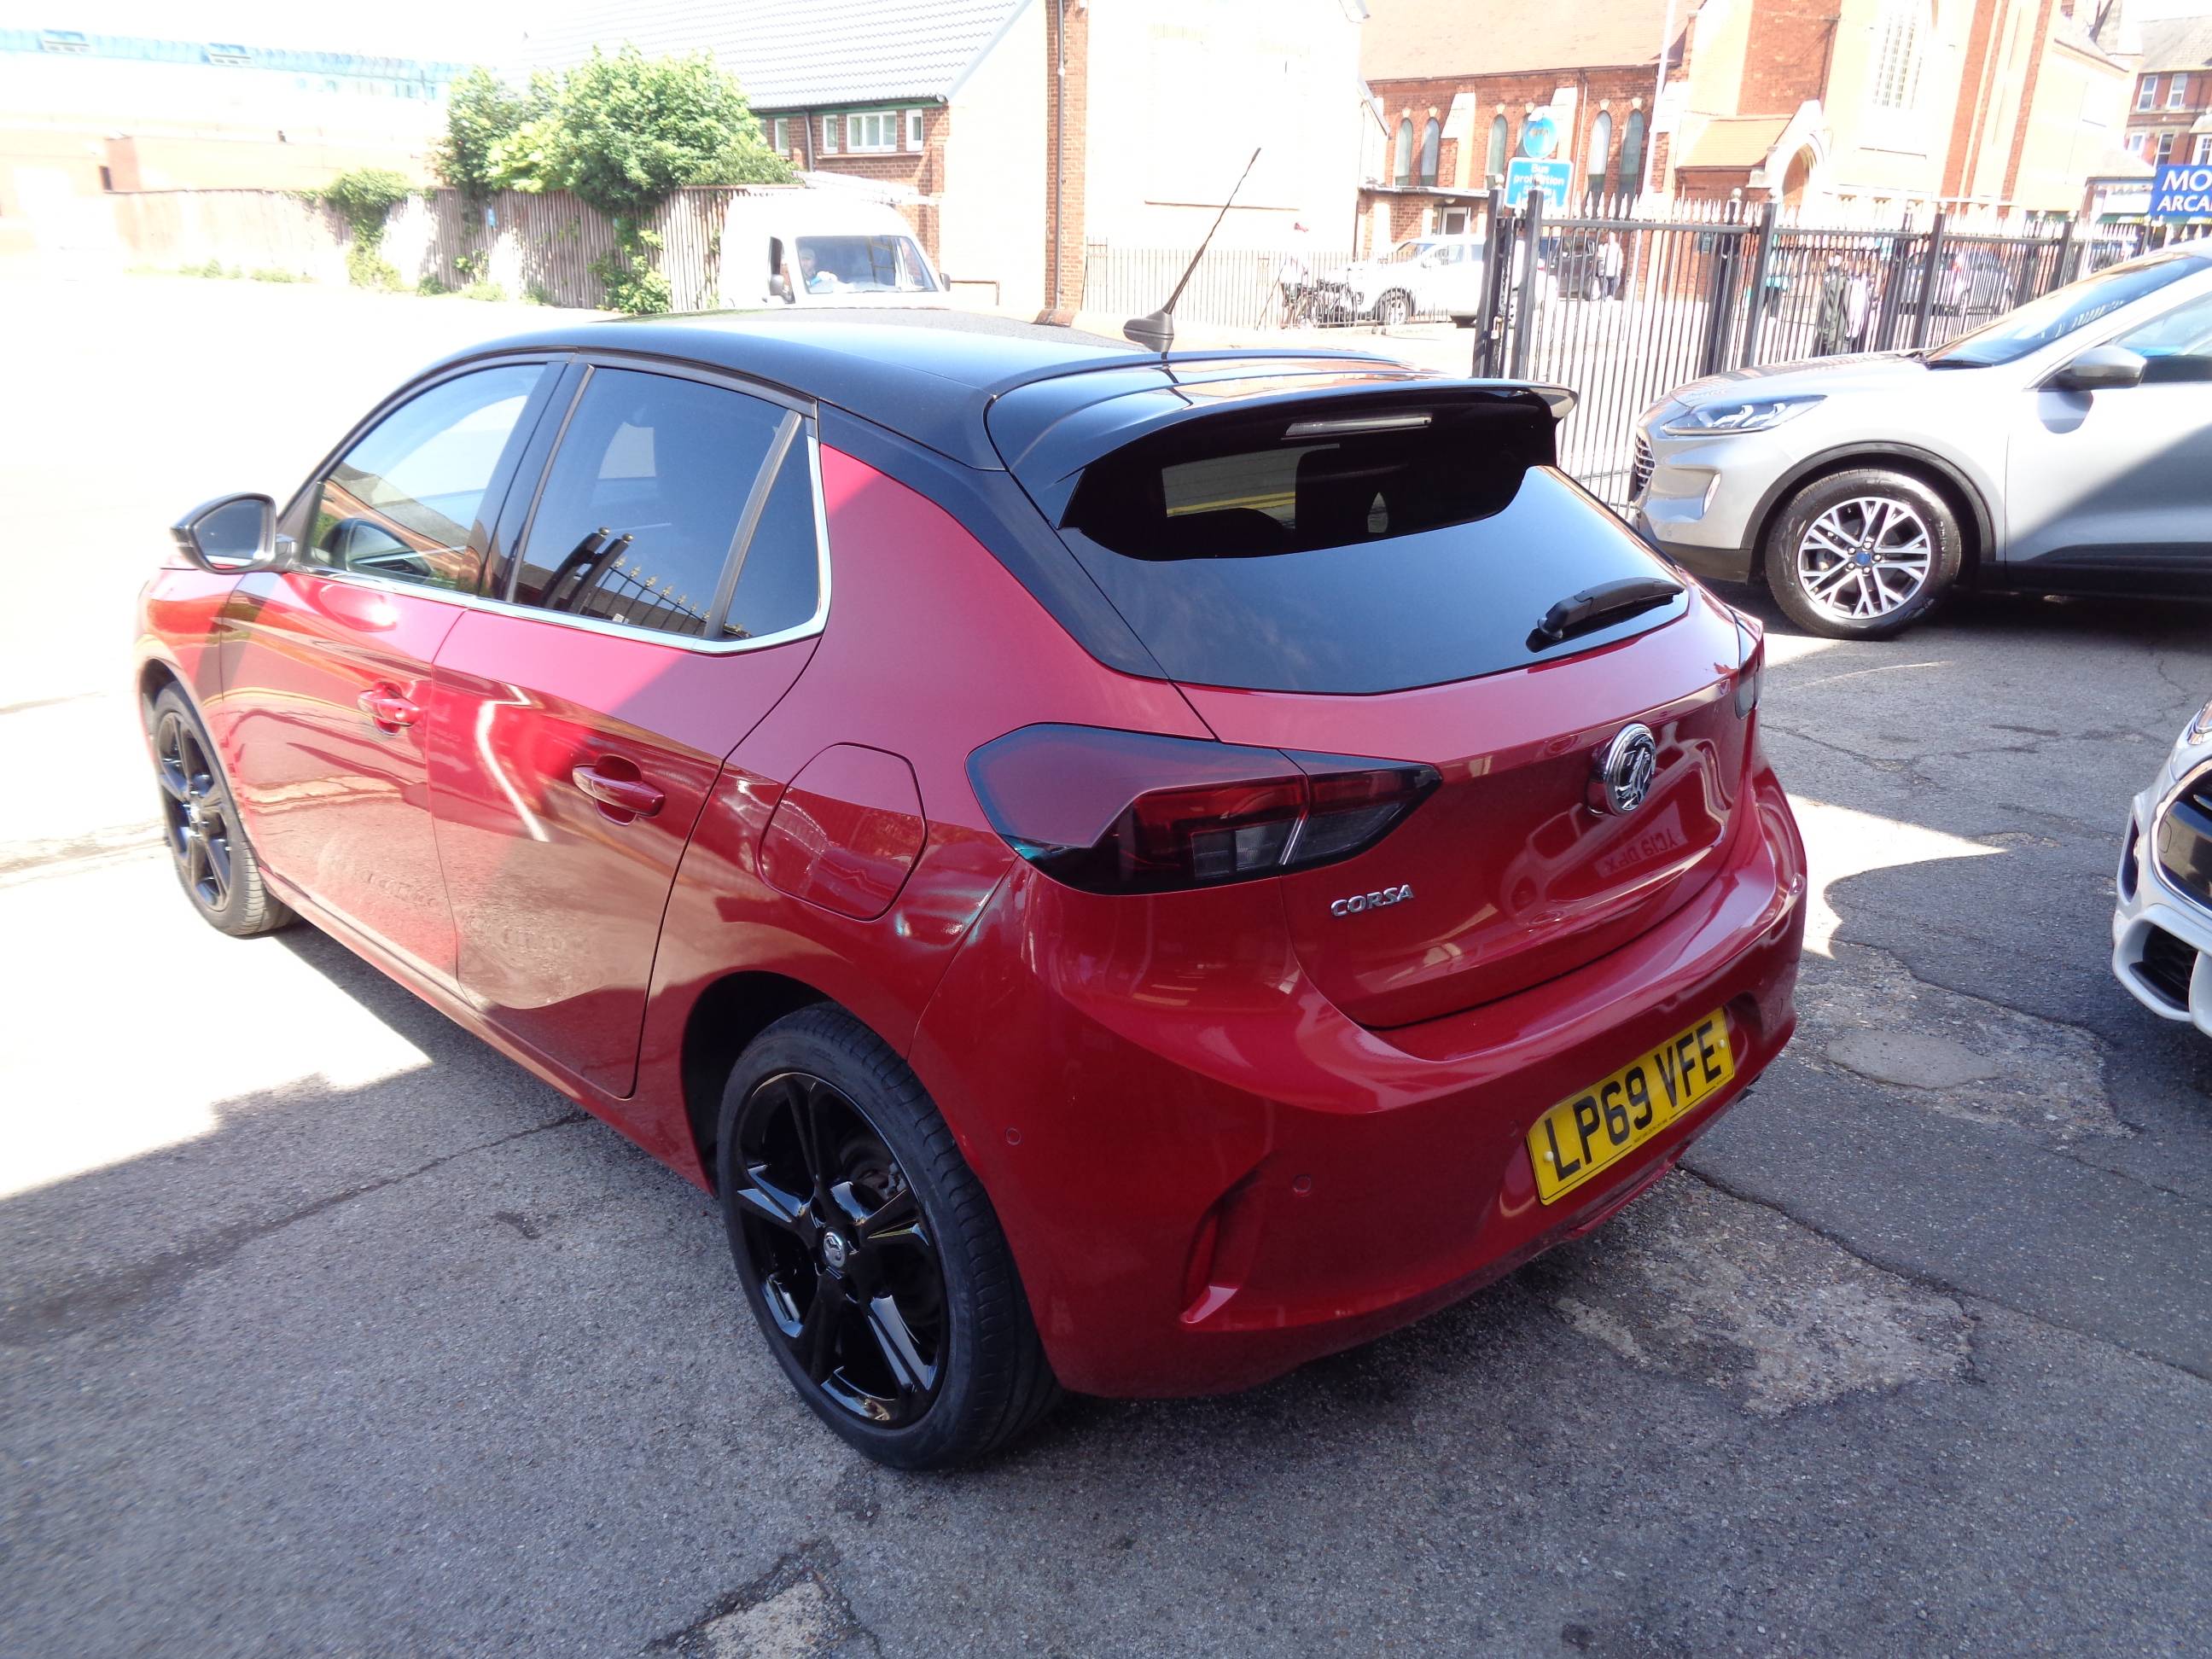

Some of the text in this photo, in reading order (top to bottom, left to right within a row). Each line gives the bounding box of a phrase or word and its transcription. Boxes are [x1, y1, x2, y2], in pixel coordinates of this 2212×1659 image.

[1531, 164, 1550, 173] Bus
[1513, 174, 1565, 185] proition
[2157, 195, 2212, 212] ARCA
[1331, 884, 1413, 916] CORSA
[1545, 1020, 1721, 1182] LP69 VFE
